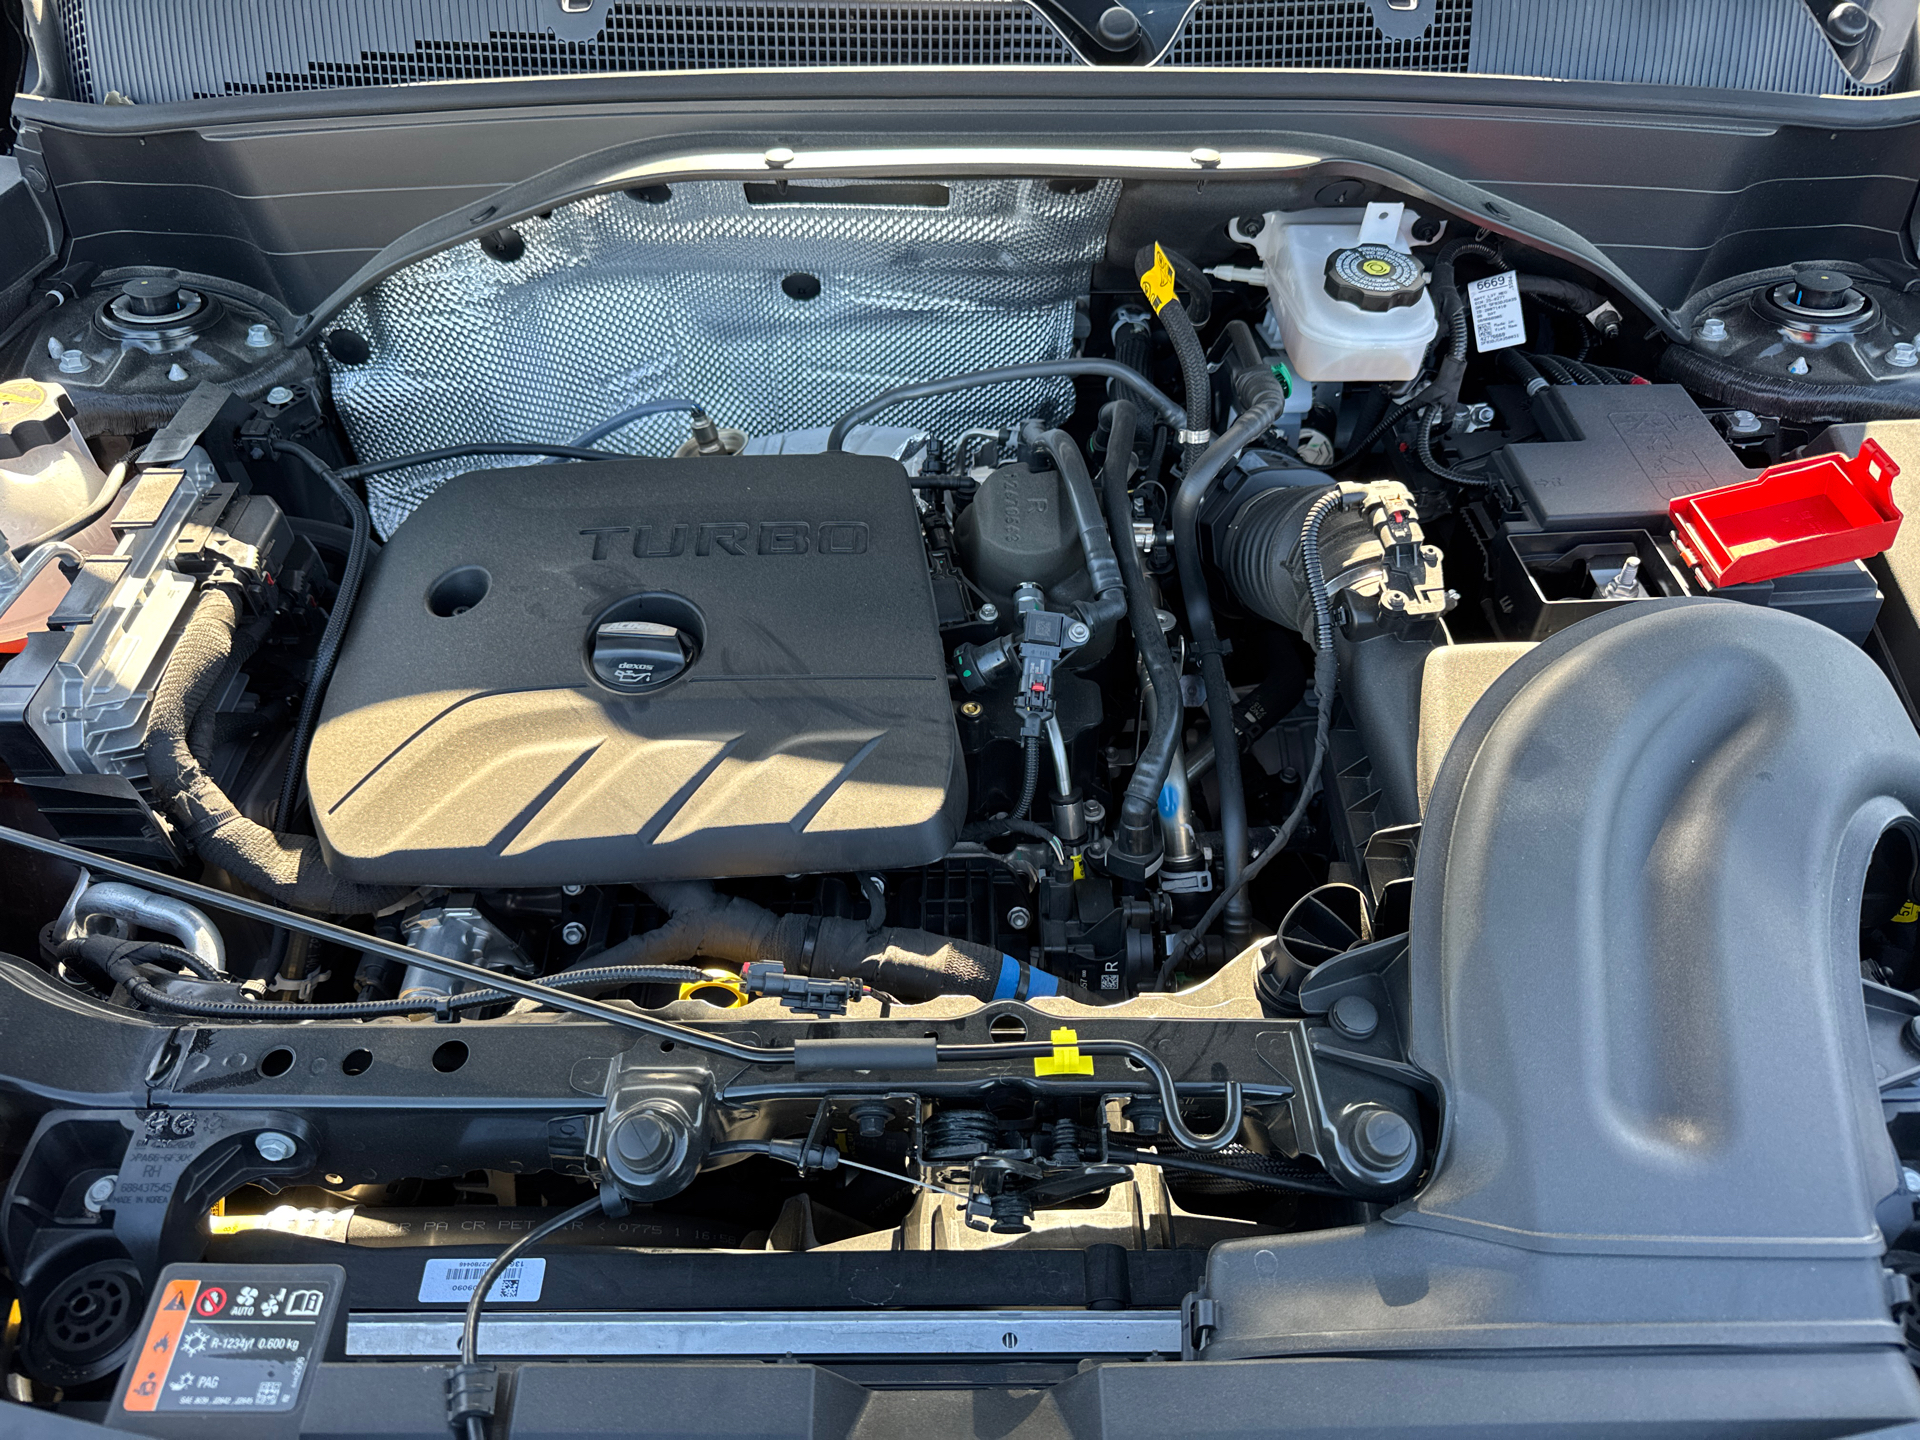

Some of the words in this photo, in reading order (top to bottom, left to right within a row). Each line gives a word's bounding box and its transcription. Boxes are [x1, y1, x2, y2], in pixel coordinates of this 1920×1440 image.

[1477, 276, 1505, 290] 6669
[579, 520, 870, 561] TURBO
[618, 662, 655, 671] dexos
[1105, 961, 1119, 972] R
[142, 1165, 162, 1178] RH
[121, 1183, 173, 1193] 688437545
[113, 1196, 132, 1204] MADE
[136, 1196, 143, 1204] IN
[145, 1196, 168, 1204] KOREA
[387, 1222, 412, 1232] CR
[423, 1221, 448, 1231] PA
[461, 1221, 486, 1231] CR
[498, 1220, 536, 1230] PET
[619, 1223, 663, 1235] 0775
[230, 1307, 255, 1316] AUTO
[210, 1338, 254, 1351] R-1234yf
[257, 1338, 286, 1349] 0.600
[286, 1338, 300, 1351] kg
[197, 1376, 220, 1388] PAG
